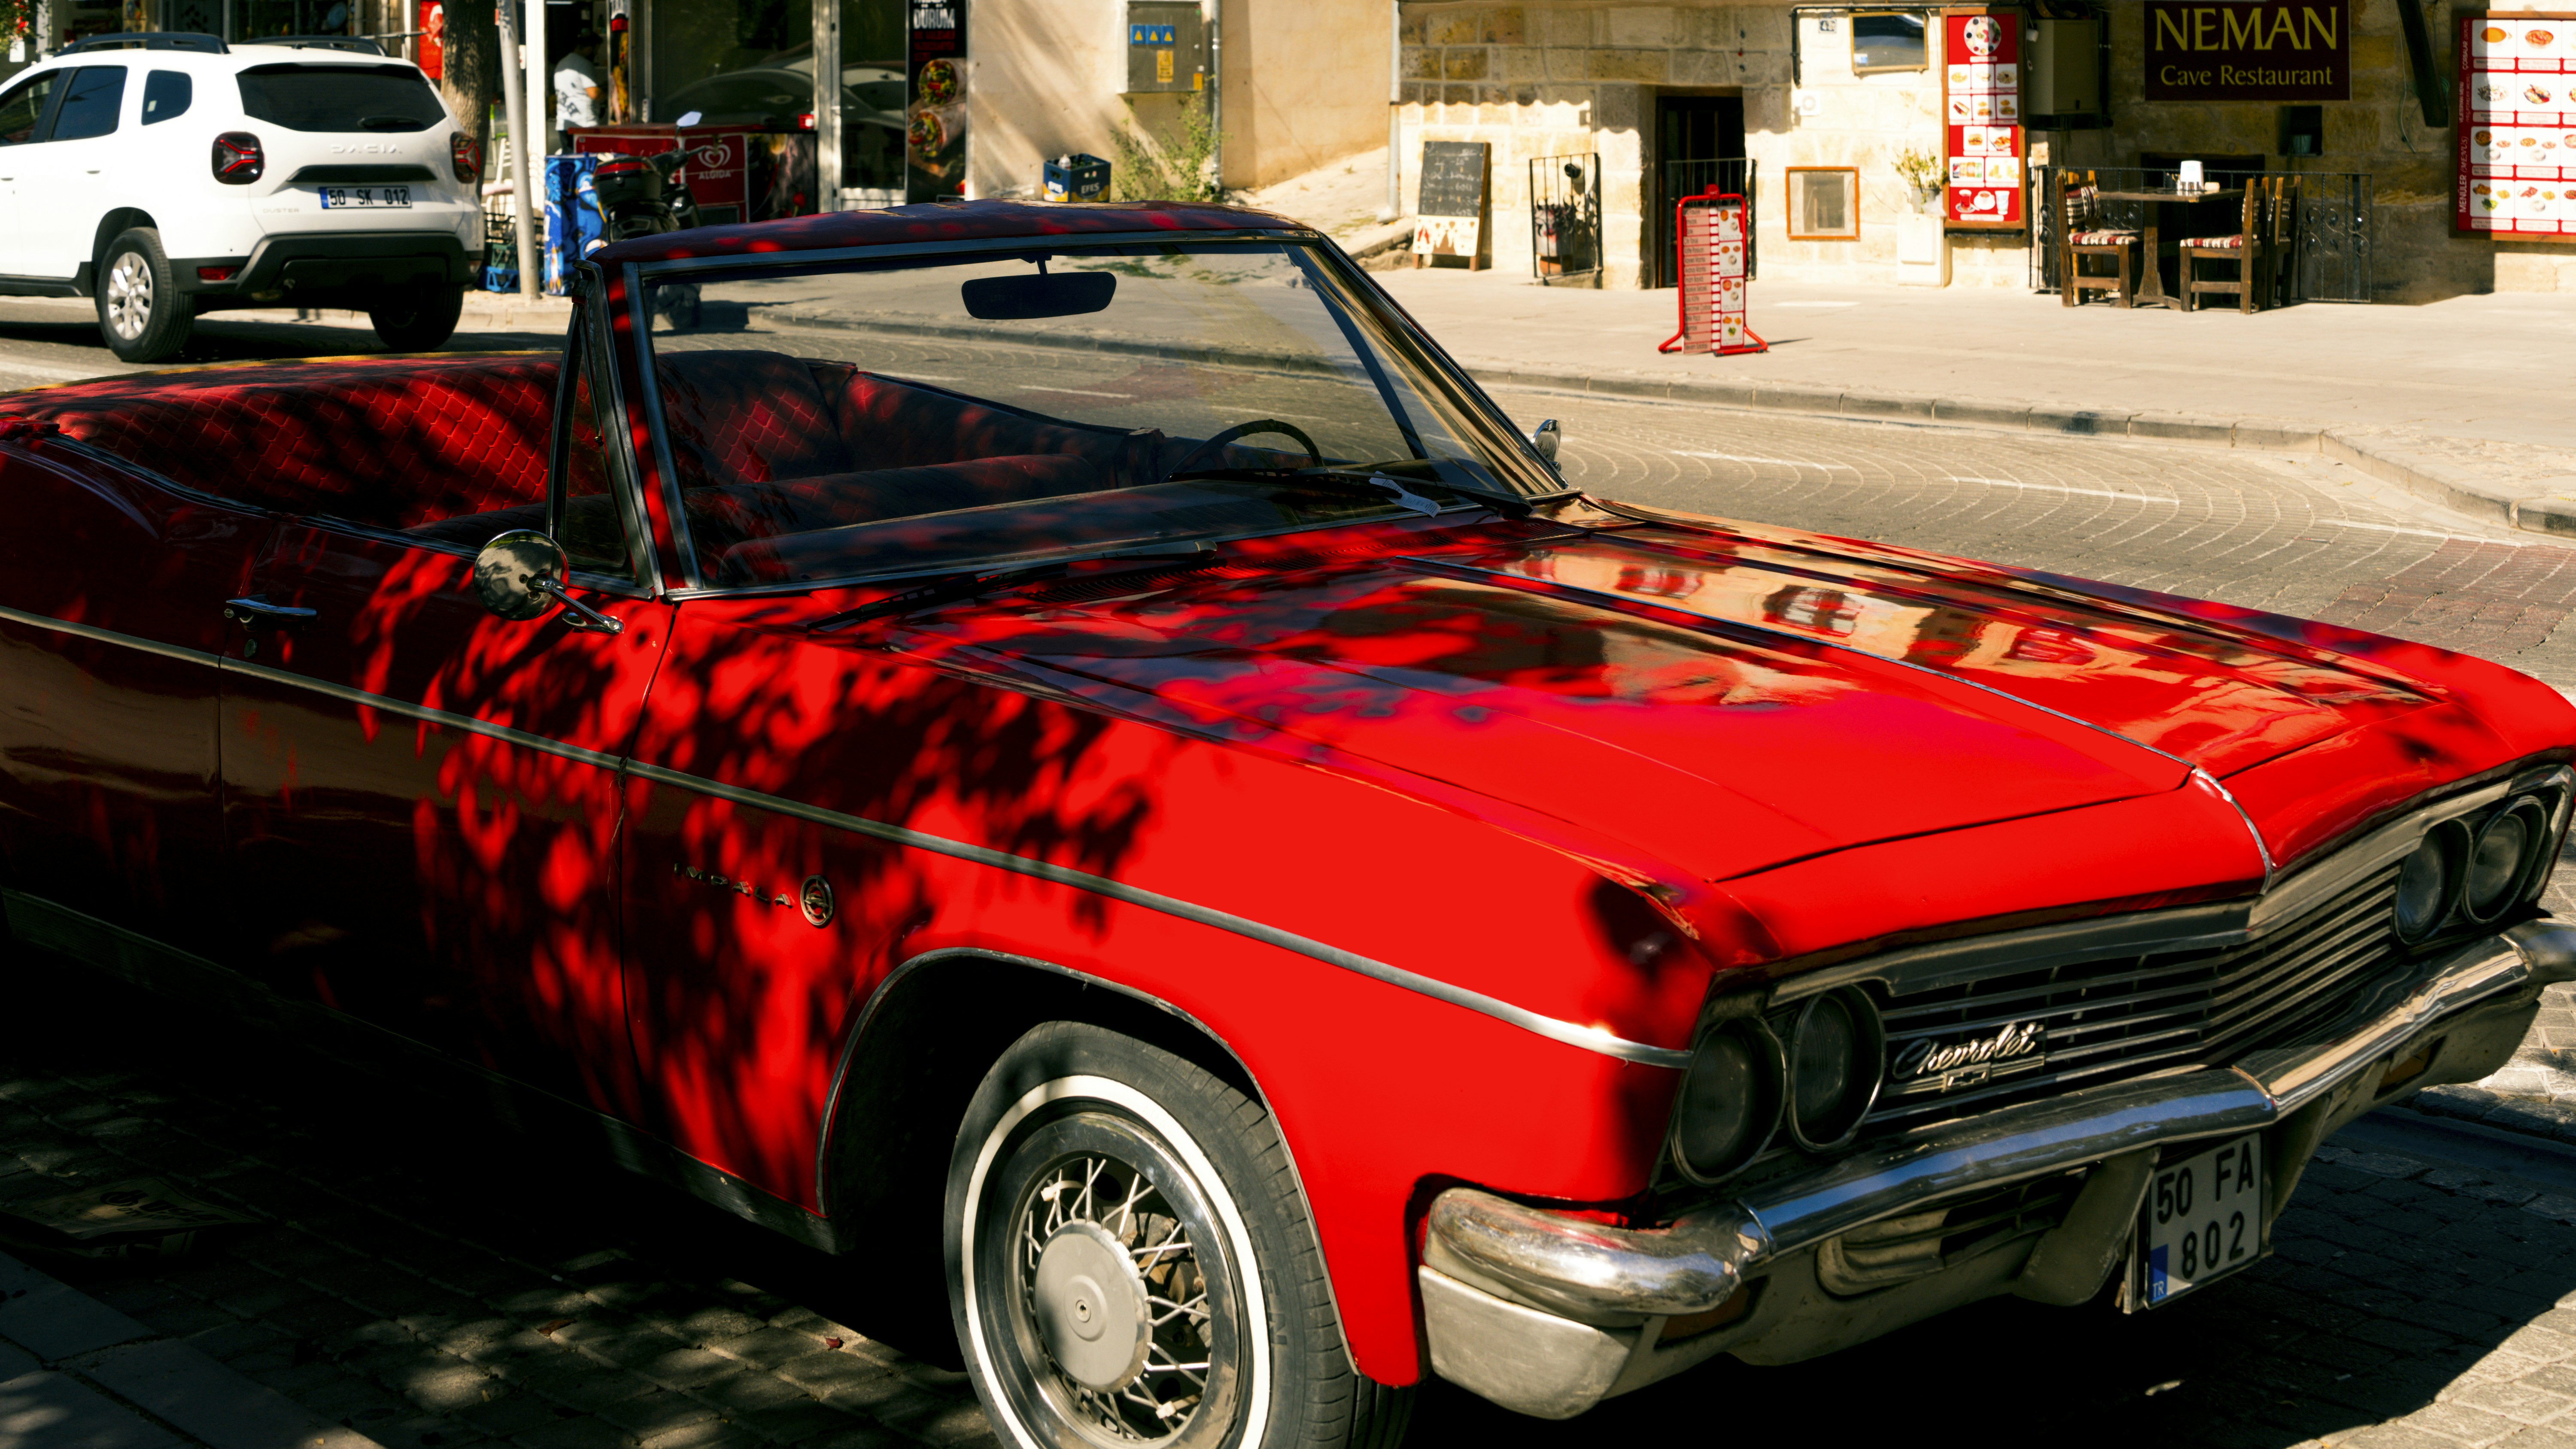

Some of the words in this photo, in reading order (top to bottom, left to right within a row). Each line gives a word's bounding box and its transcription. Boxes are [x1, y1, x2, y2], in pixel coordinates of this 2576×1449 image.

[913, 3, 955, 29] DÜRÜM
[2155, 7, 2337, 51] NEMAN
[2161, 65, 2211, 85] Cave
[2221, 64, 2333, 85] Restaurant
[699, 170, 731, 180] ALGIDA
[1081, 182, 1100, 194] EFES
[328, 189, 346, 205] 50
[357, 188, 373, 205] SK
[384, 188, 408, 205] 012
[2458, 174, 2467, 213] MENÜLER
[674, 863, 795, 908] IMPALA
[1893, 1022, 2044, 1079] Chevrolet
[2157, 1167, 2193, 1224] 50
[2216, 1141, 2254, 1202] FA
[2182, 1211, 2245, 1280] 802
[2153, 1280, 2165, 1298] TR
